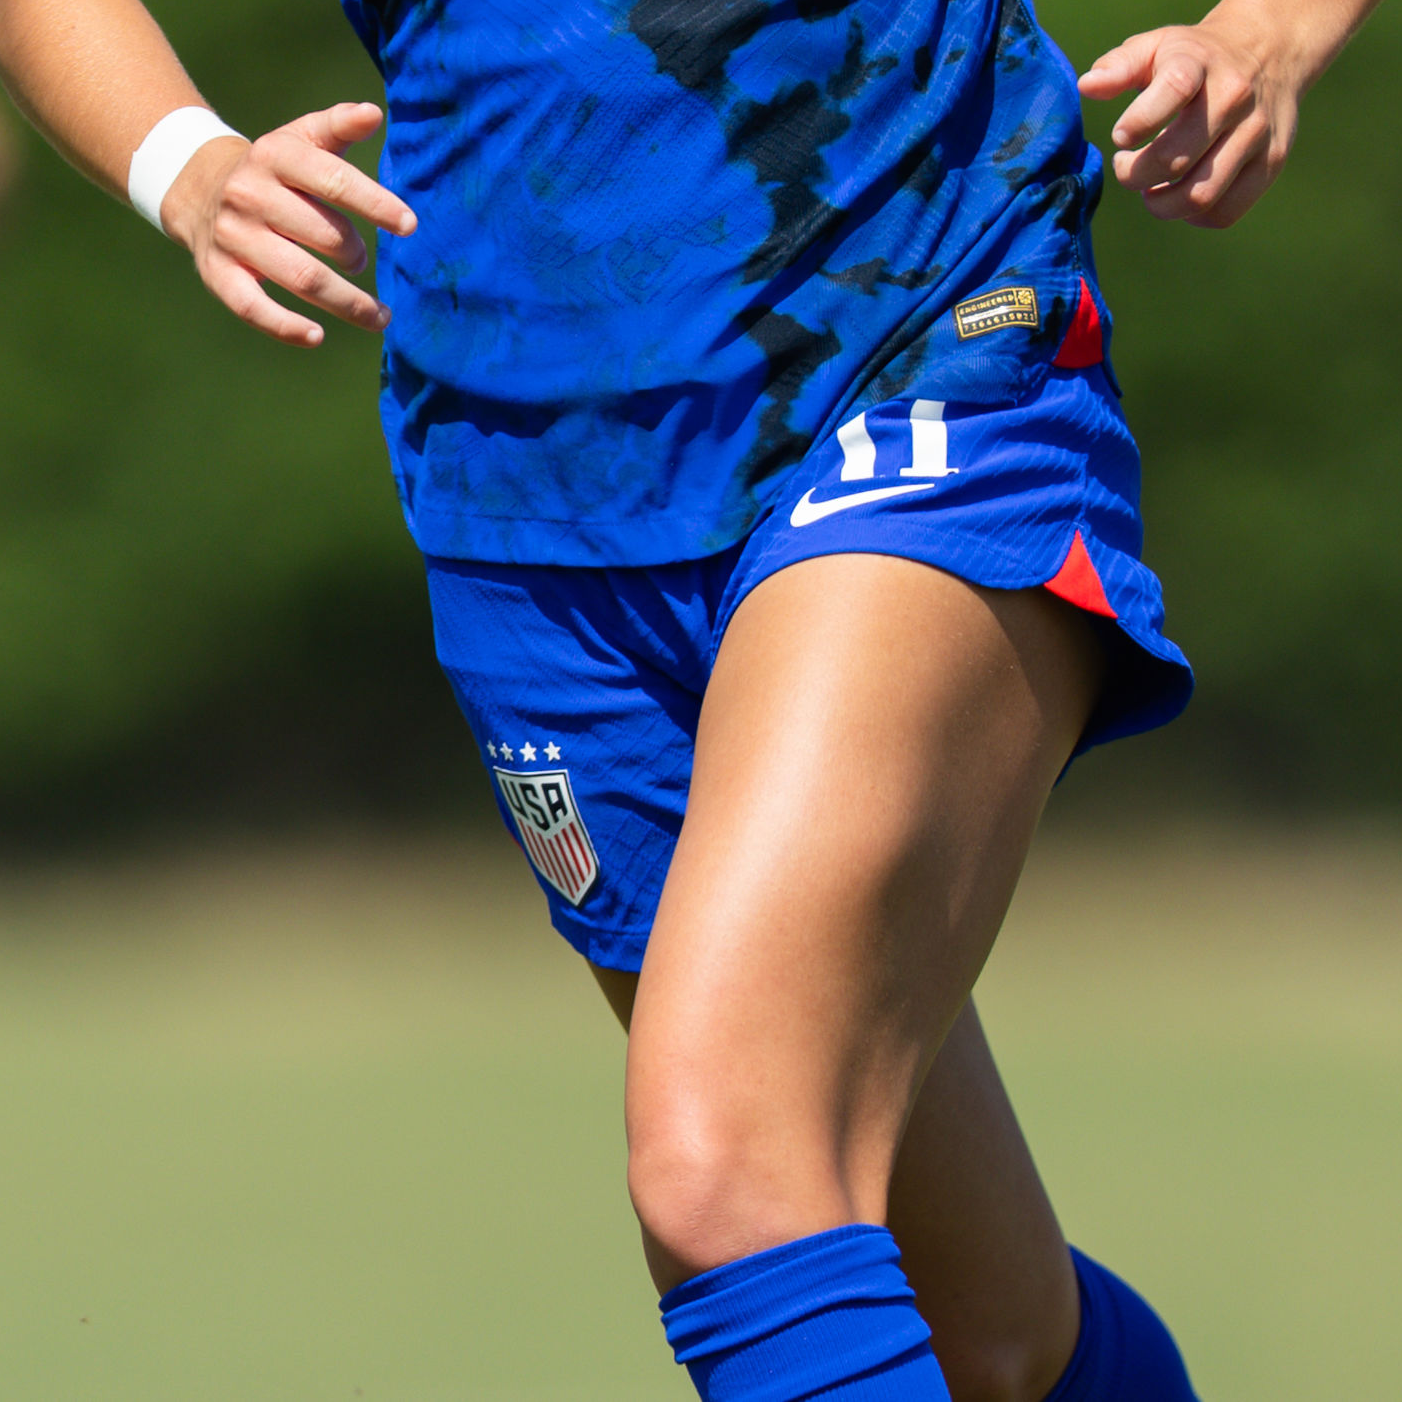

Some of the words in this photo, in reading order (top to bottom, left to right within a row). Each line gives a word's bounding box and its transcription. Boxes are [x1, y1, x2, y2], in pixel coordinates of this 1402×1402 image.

[959, 294, 1014, 315] ENGINEERED
[836, 398, 960, 482] 11
[500, 779, 568, 831] USA
